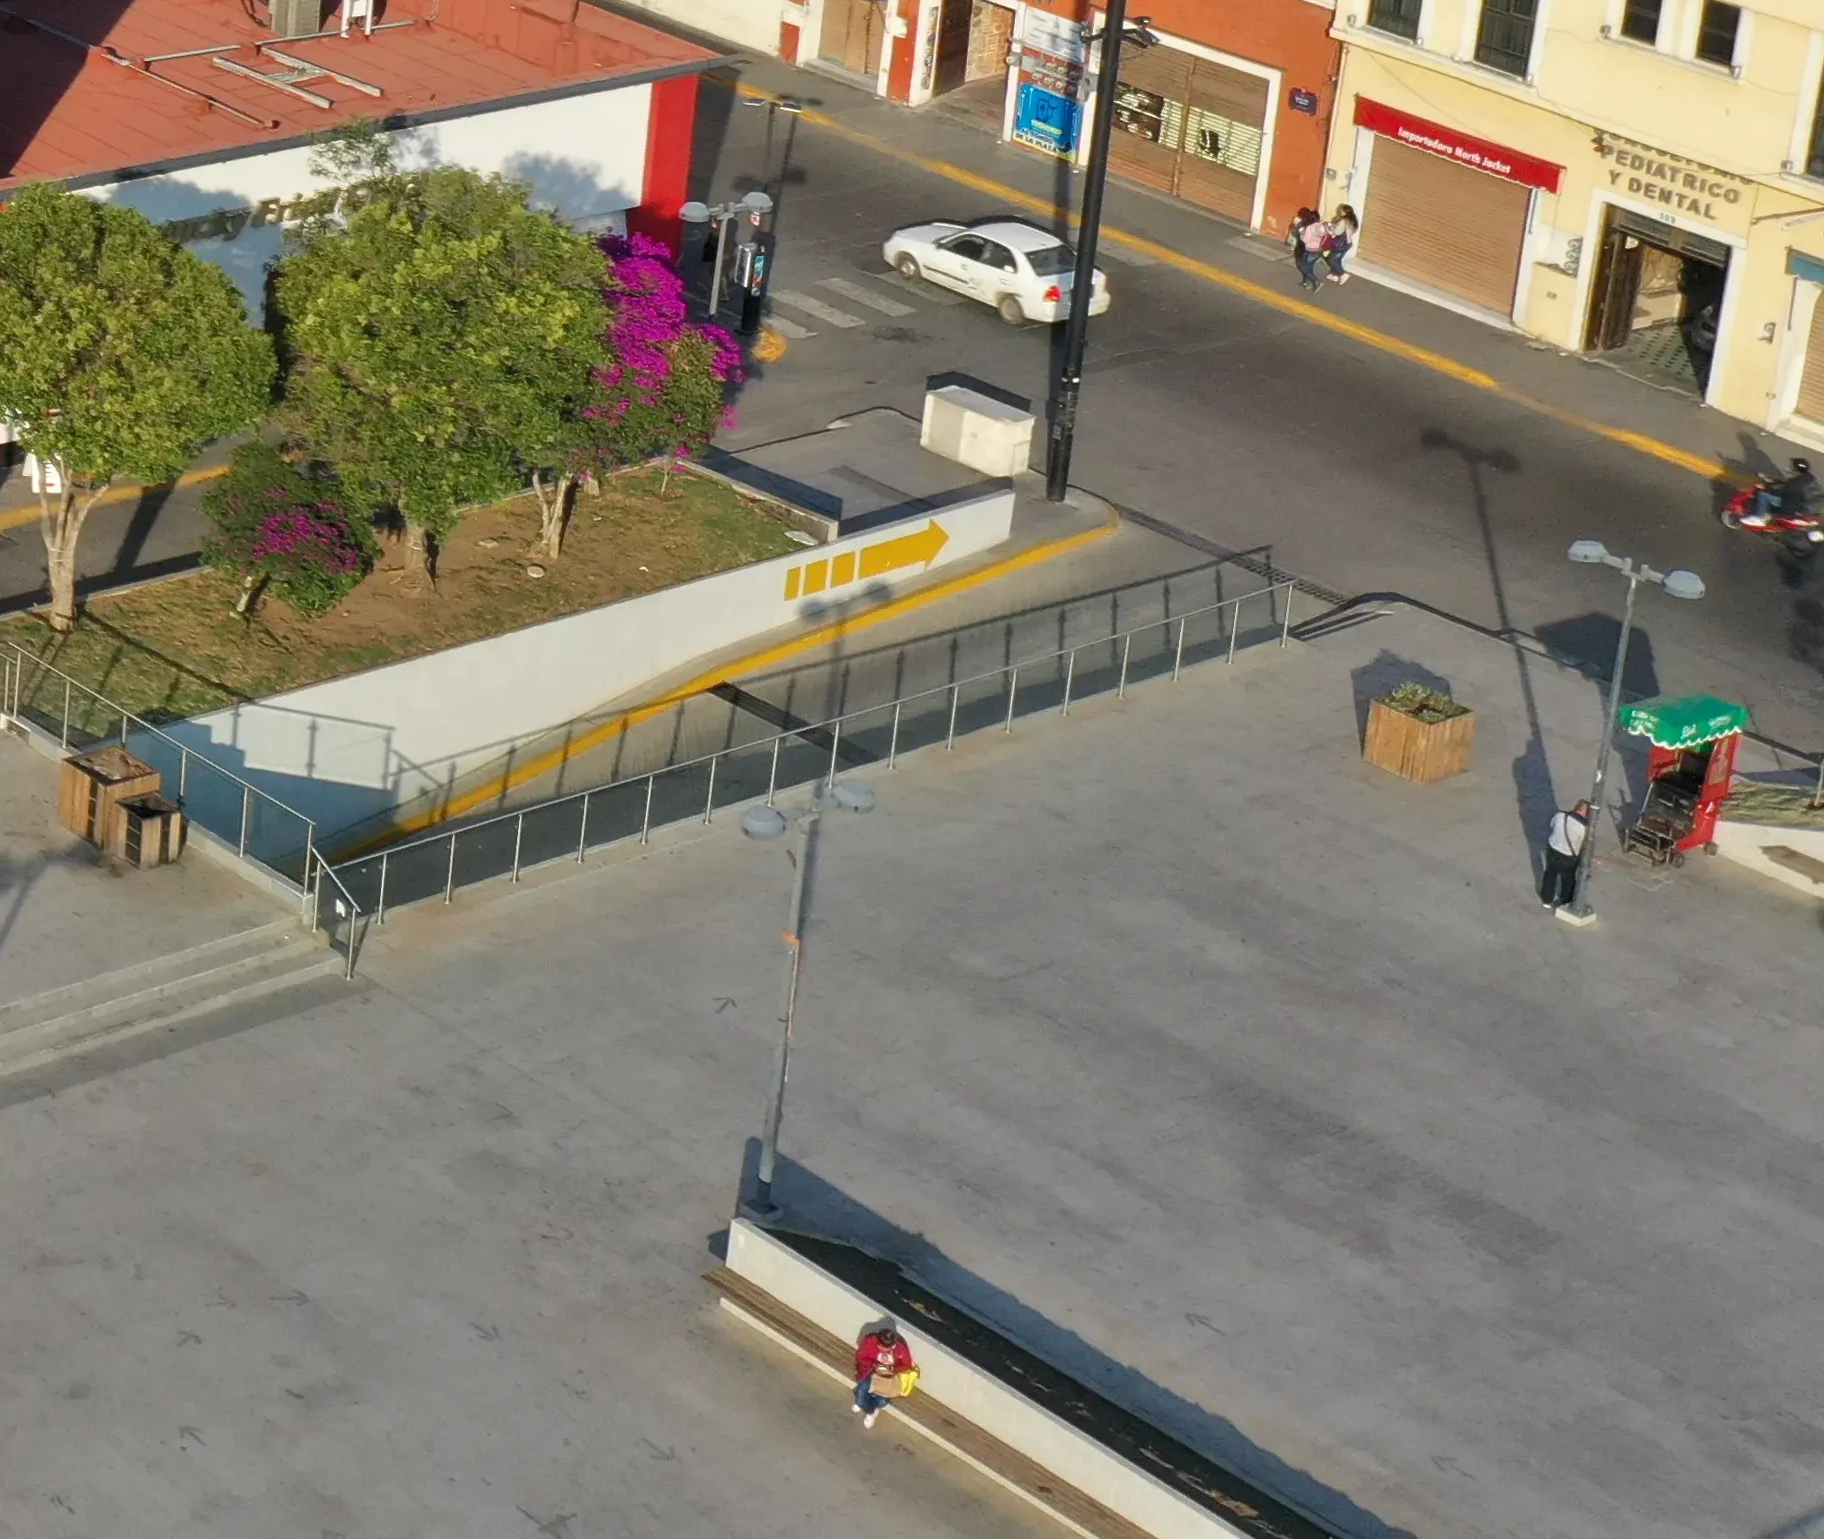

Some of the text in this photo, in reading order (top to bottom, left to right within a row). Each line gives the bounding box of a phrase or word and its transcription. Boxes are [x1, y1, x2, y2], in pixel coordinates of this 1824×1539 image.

[1601, 145, 1741, 204] PEDIATRICO
[1608, 169, 1719, 220] Y DENTAL
